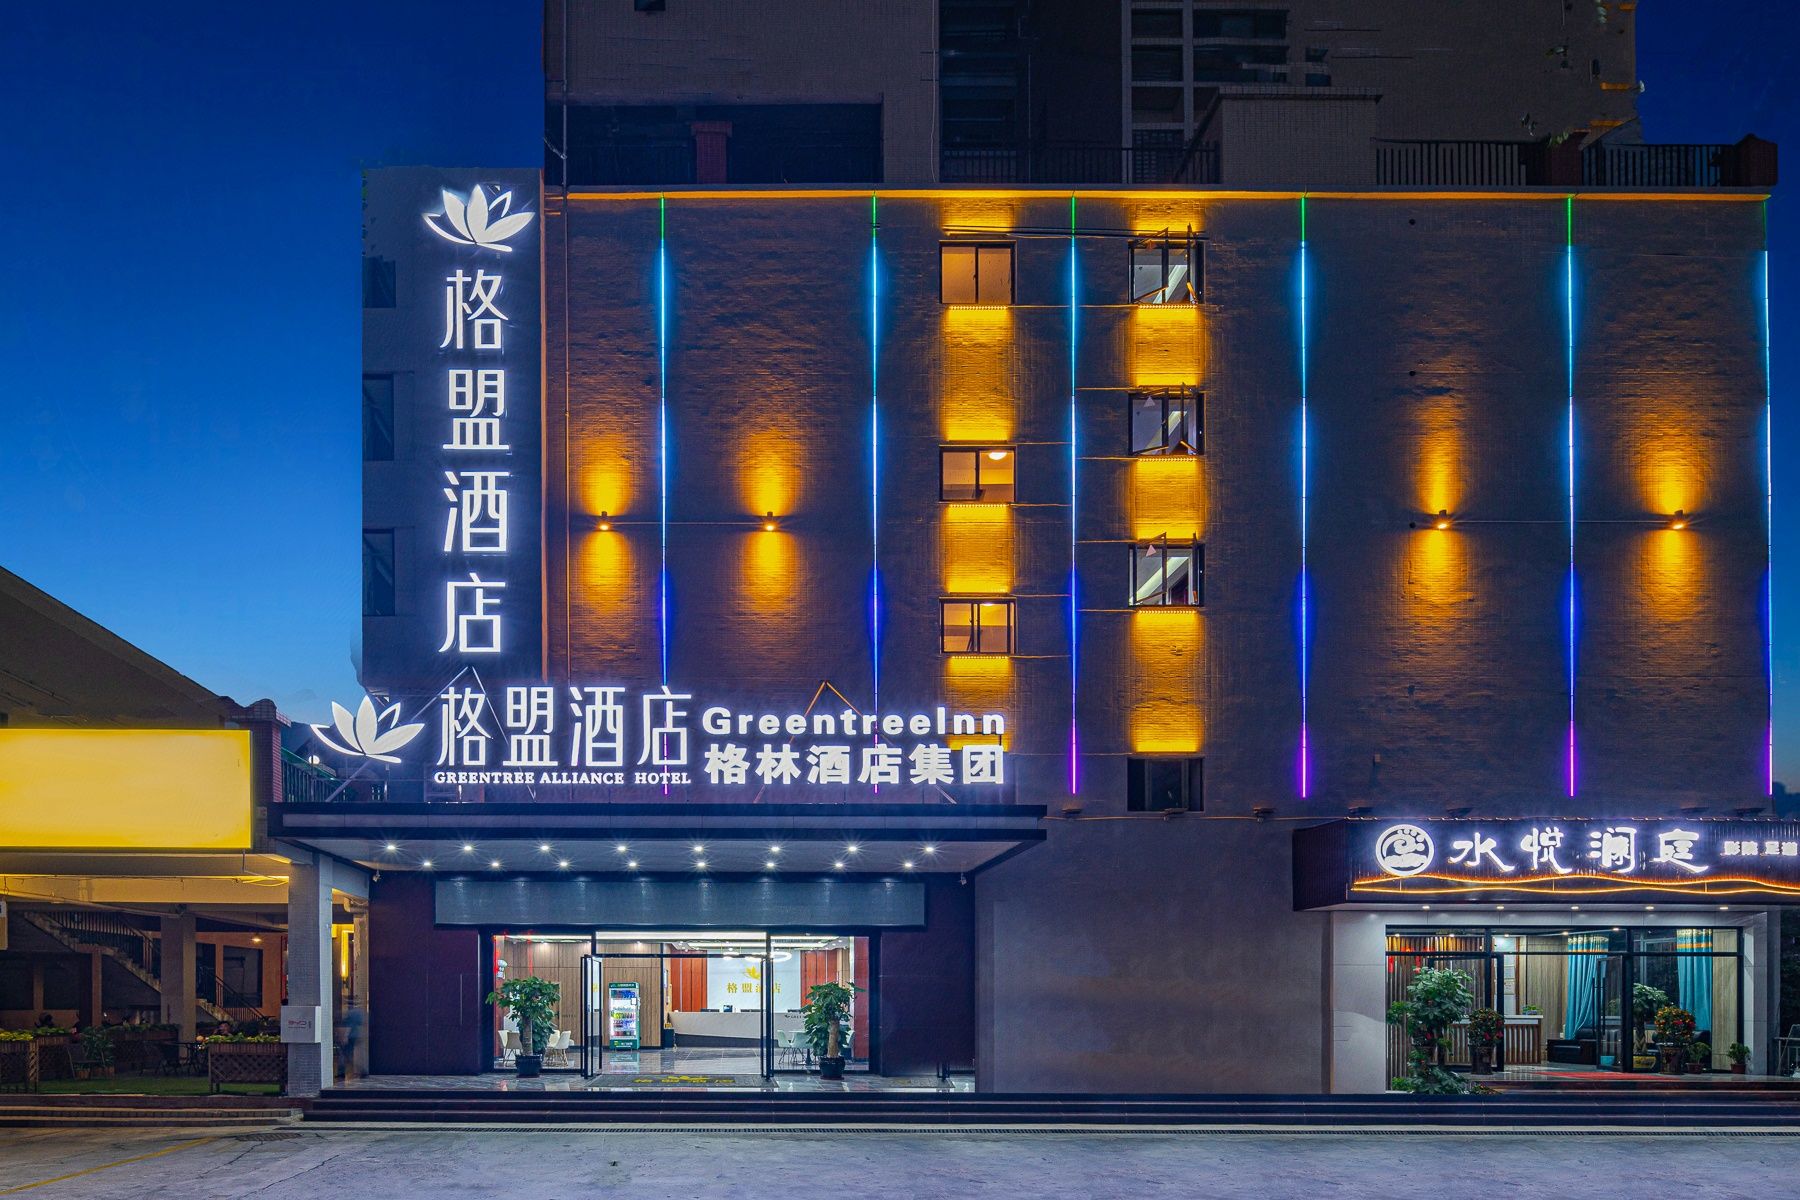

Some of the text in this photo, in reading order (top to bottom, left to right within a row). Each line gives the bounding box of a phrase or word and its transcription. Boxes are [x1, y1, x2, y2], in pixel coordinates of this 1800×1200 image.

[439, 269, 510, 654] 格盟酒店
[436, 686, 692, 767] 格盟酒店
[702, 707, 1005, 735] GreentreeInn
[434, 772, 691, 784] GREENTREE ALLIANCE HOTEL
[704, 743, 1004, 785] 格林酒店集团
[1448, 826, 1709, 874] 水悦澜庭
